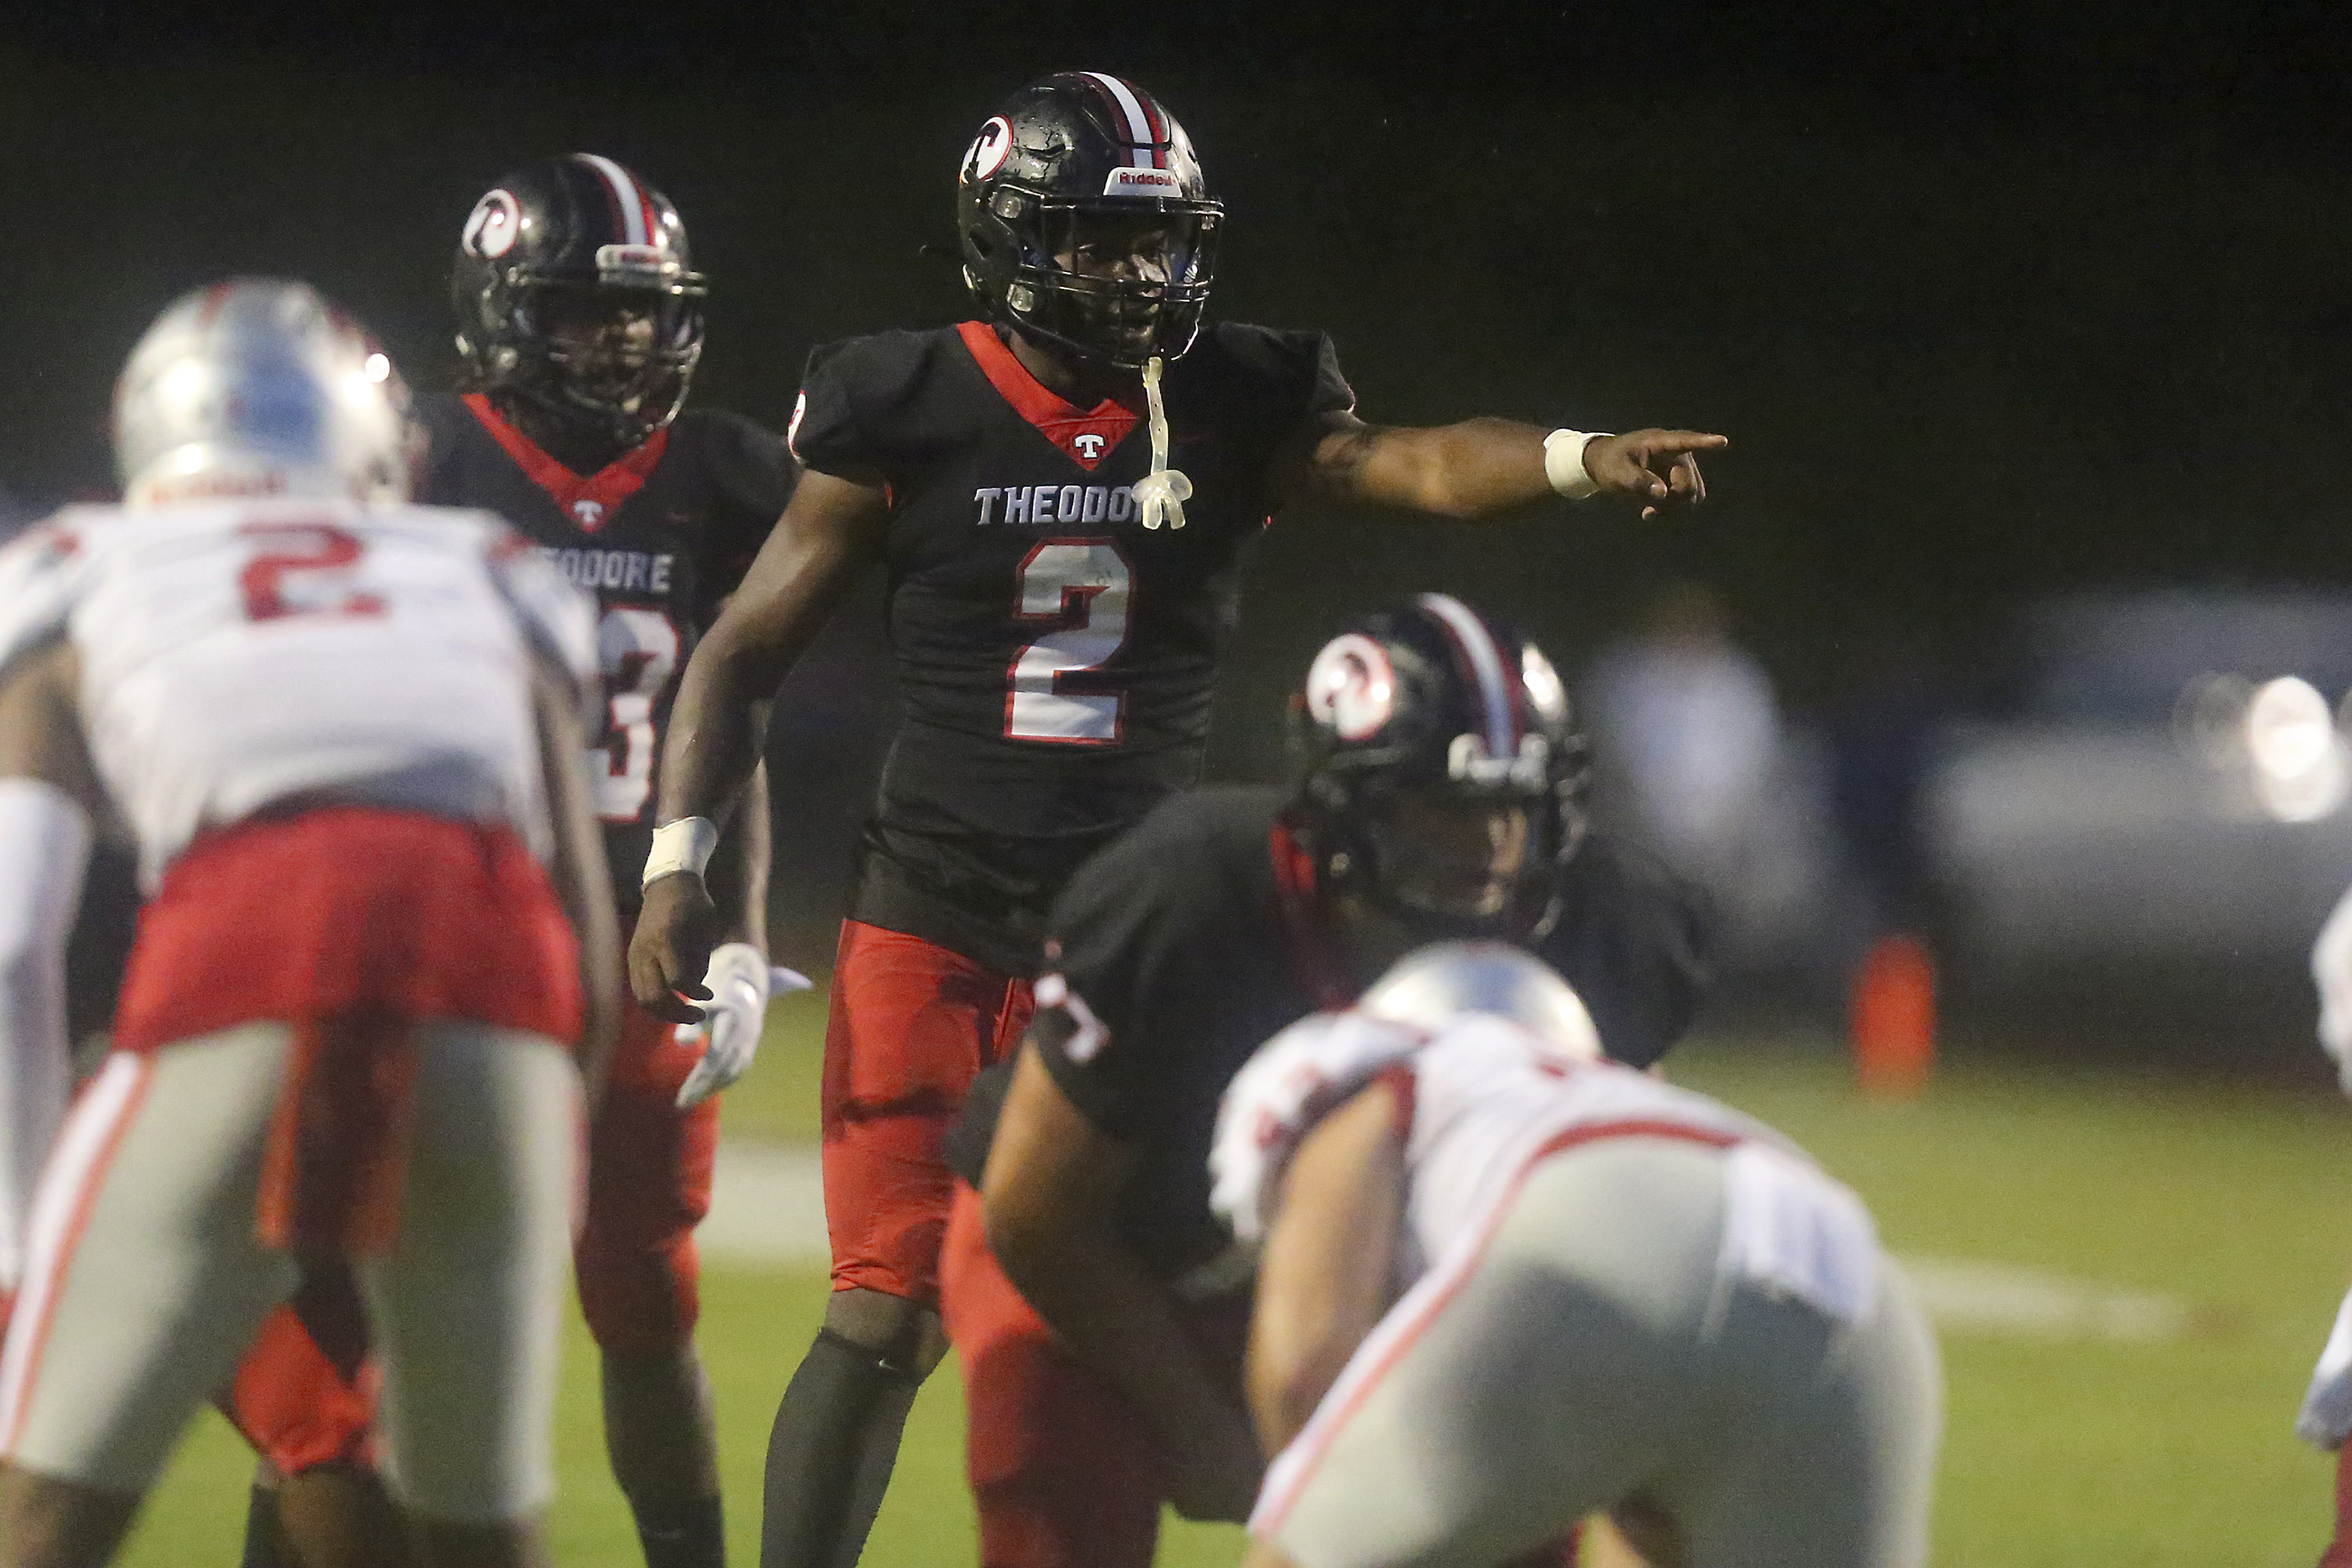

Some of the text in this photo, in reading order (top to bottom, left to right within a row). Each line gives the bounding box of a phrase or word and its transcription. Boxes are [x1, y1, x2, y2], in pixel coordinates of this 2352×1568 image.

[1074, 434, 1105, 459] T
[573, 499, 604, 524] T
[975, 485, 1144, 524] THEODO
[238, 521, 385, 622] 2
[549, 548, 673, 593] ODORE
[1004, 536, 1134, 746] 2
